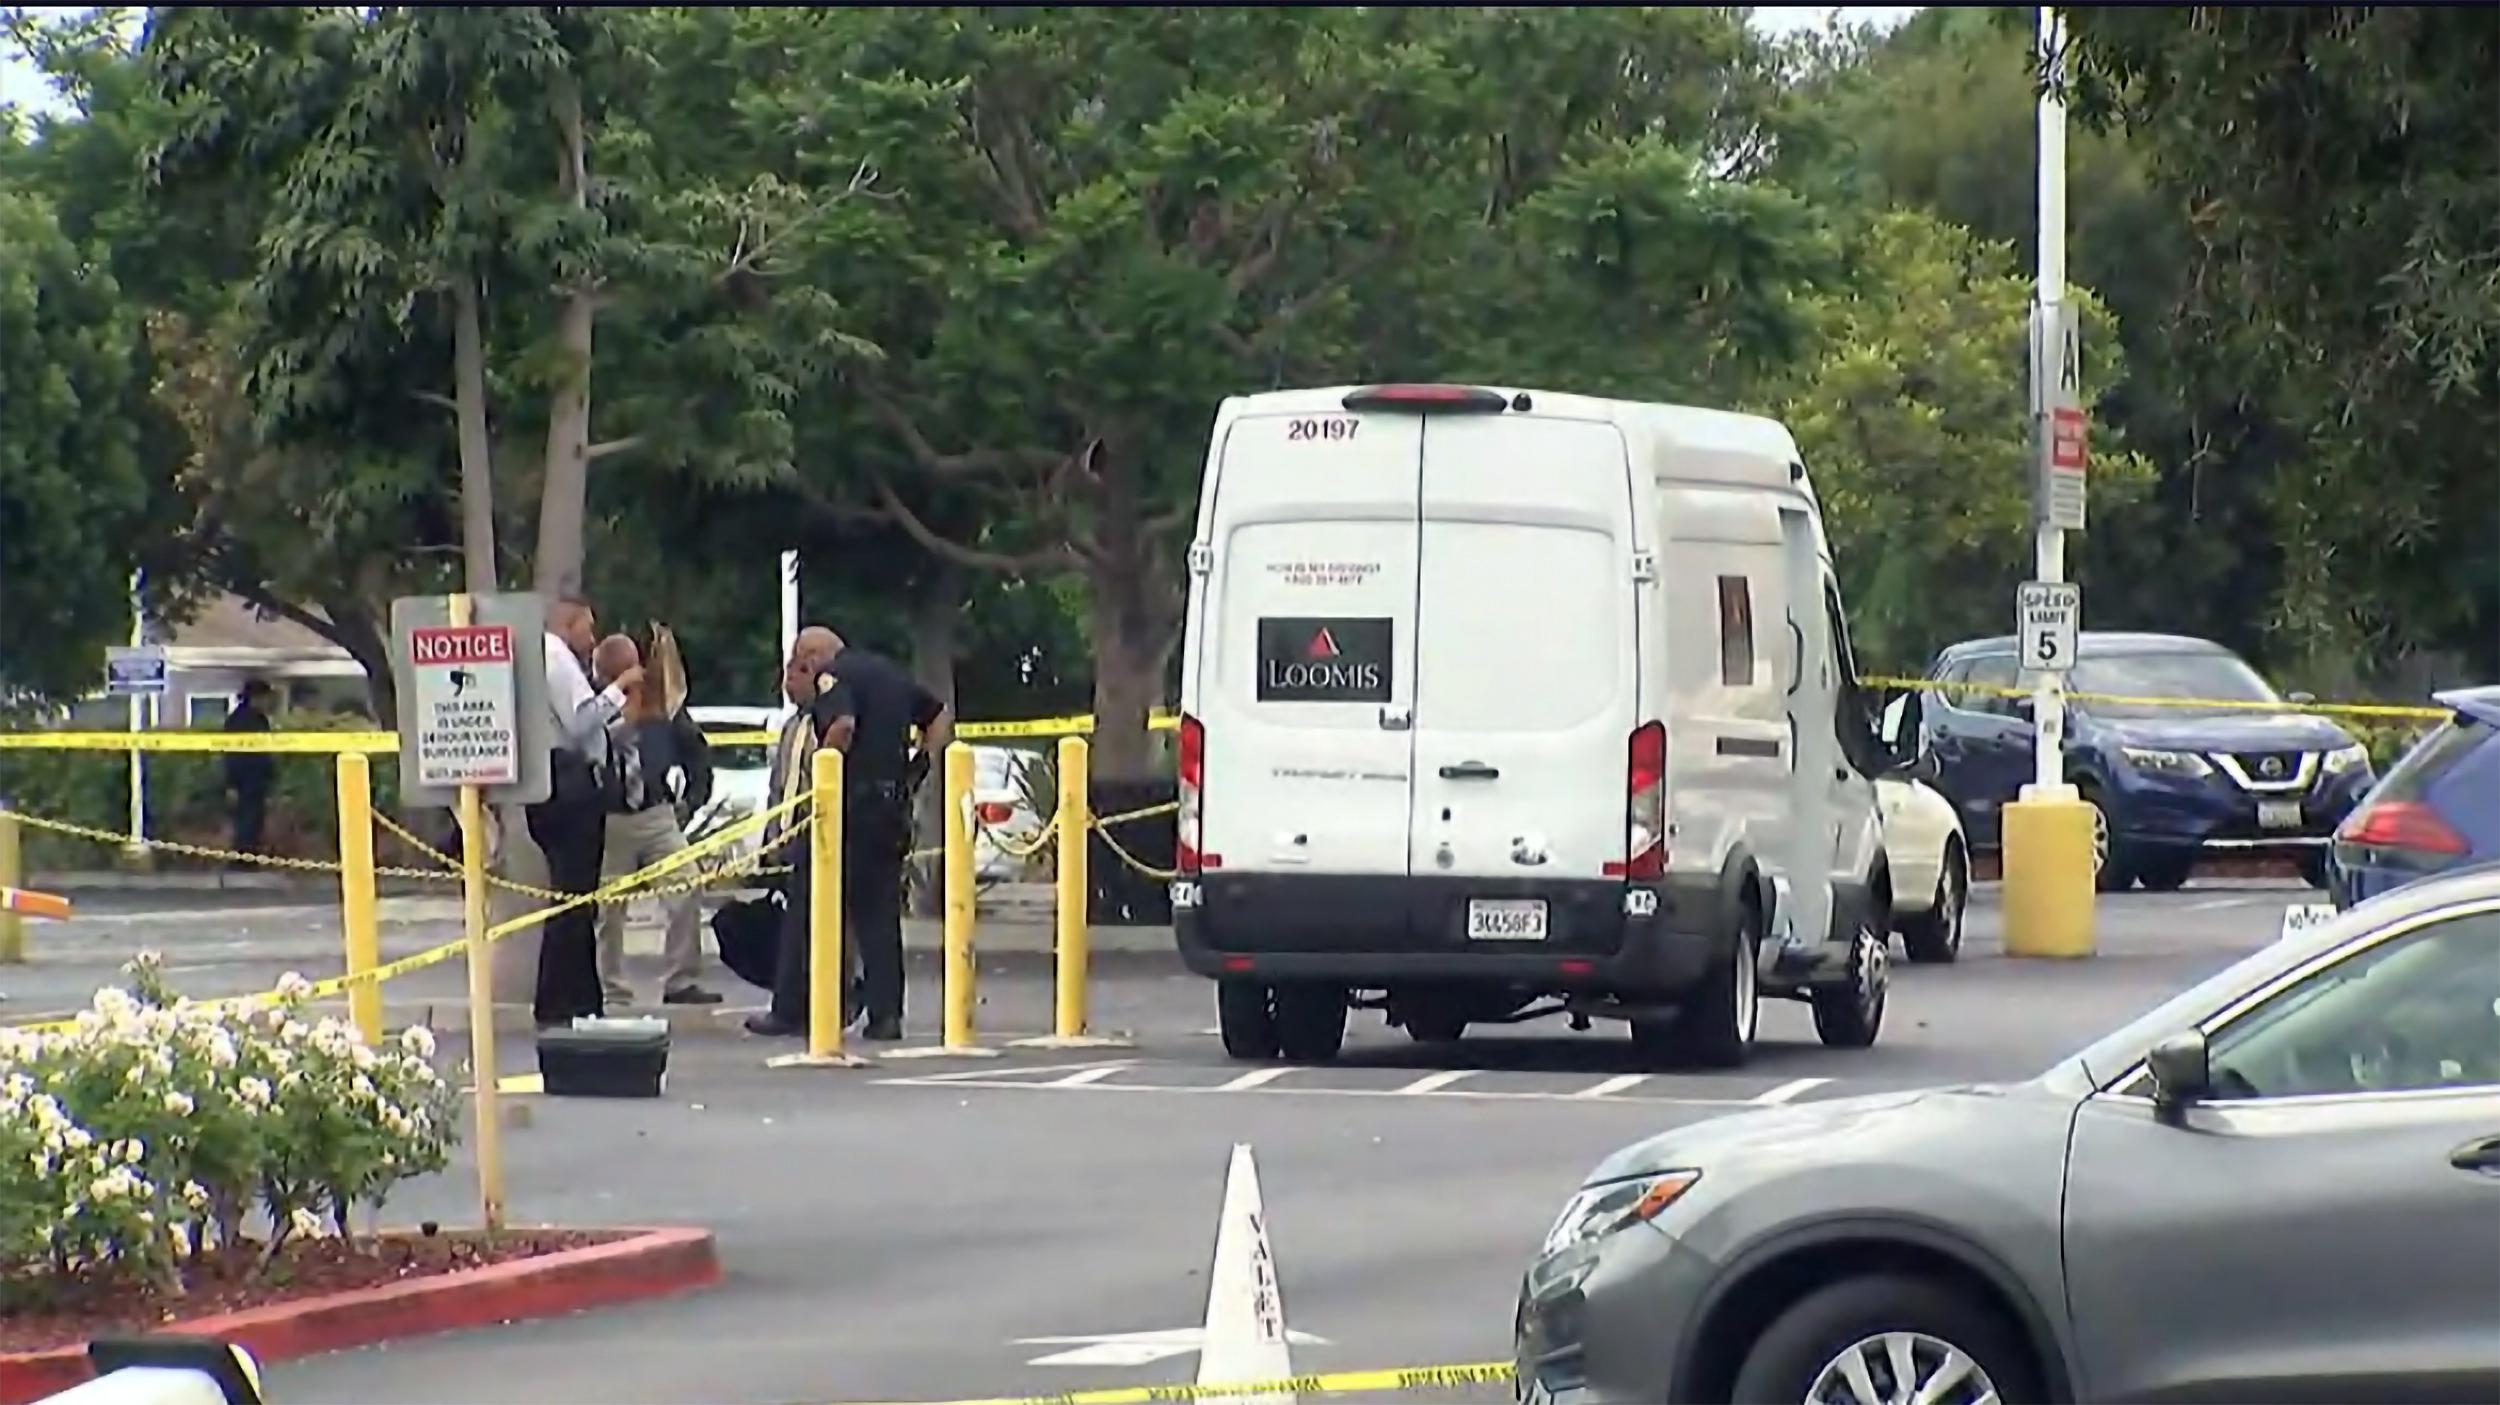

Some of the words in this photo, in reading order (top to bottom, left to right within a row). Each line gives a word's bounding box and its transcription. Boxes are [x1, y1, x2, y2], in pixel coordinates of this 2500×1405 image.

[1288, 419, 1360, 440] 20197
[2024, 593, 2075, 608] SPEED
[2030, 610, 2065, 624] LIMIT
[416, 634, 506, 660] NOTICE
[2037, 630, 2057, 660] 5
[1268, 659, 1379, 690] LOOMIS
[434, 702, 460, 714] THIS
[462, 700, 495, 713] AREA
[437, 716, 449, 728] IS
[451, 715, 493, 728] UNDER
[437, 731, 471, 743] HOUR
[474, 729, 510, 742] VIDEO
[1248, 1213, 1279, 1338] VALET
